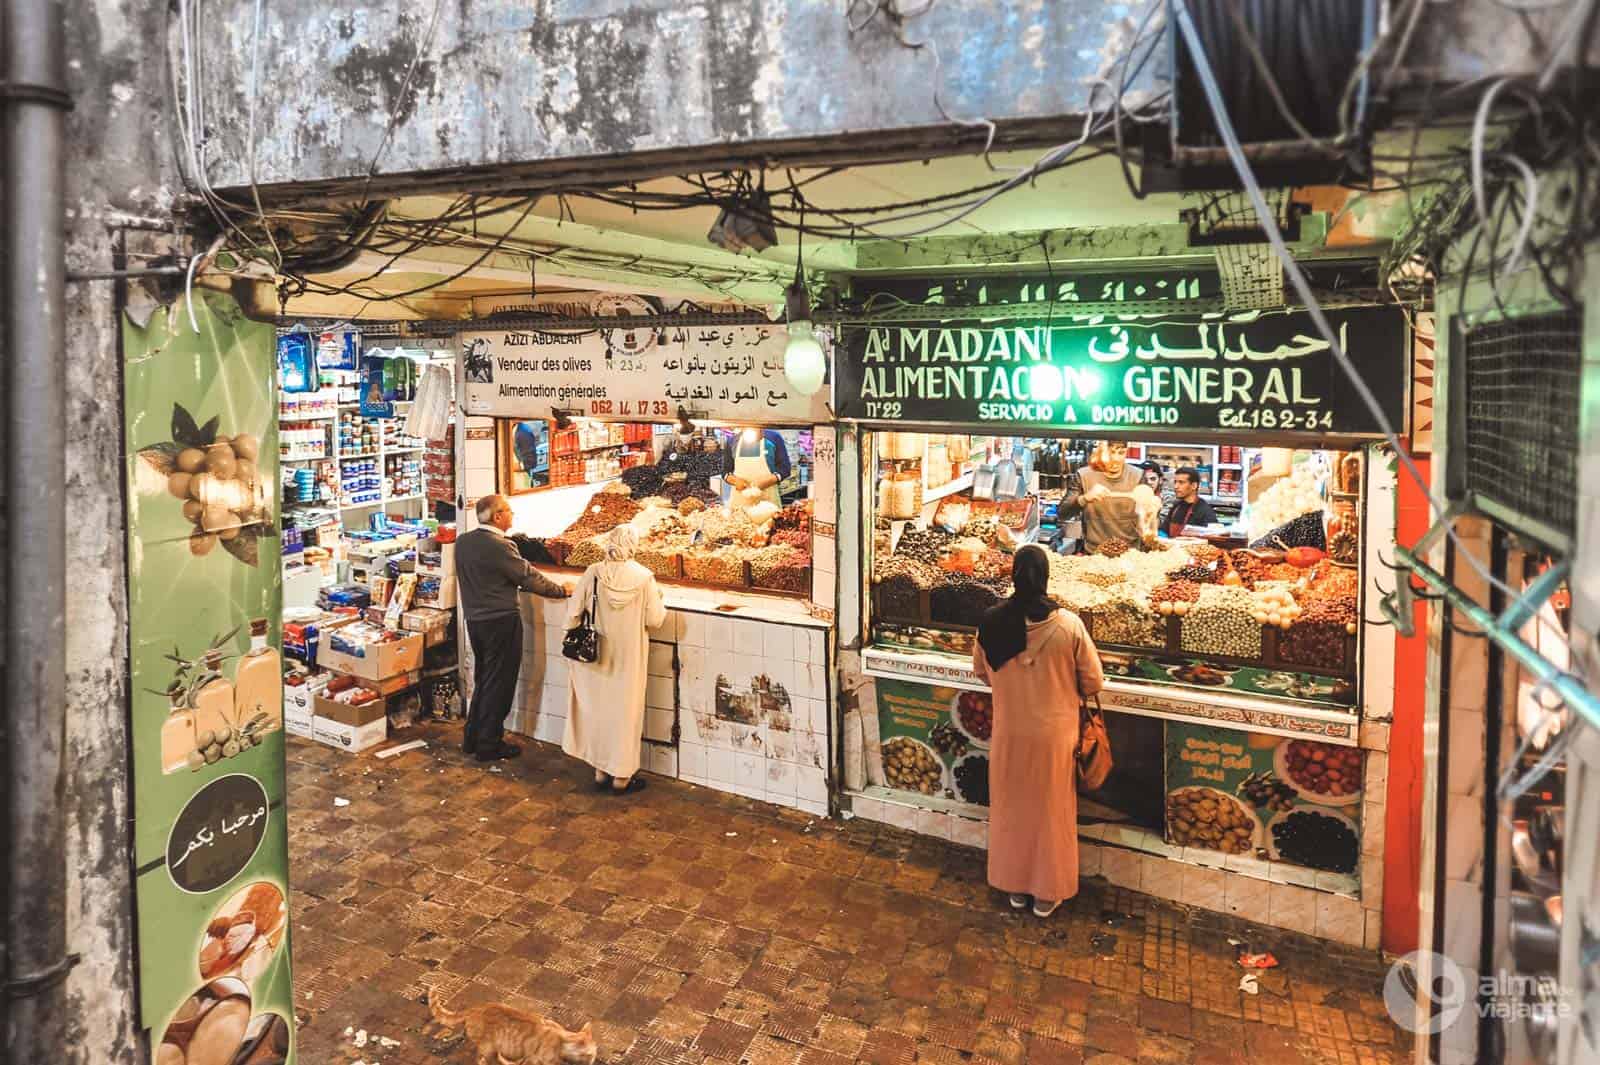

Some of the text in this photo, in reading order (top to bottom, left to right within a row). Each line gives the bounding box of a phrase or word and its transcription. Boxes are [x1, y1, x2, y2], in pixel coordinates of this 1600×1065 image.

[504, 334, 529, 346] AZIZI
[698, 329, 722, 348] عبد
[497, 356, 593, 372] Vendeur des olives
[499, 384, 608, 401] Alimentation générales
[860, 365, 1321, 405] ALIMENTACN GENERAL
[766, 391, 788, 406] مع
[591, 400, 613, 415] 062
[638, 400, 649, 416] 17
[653, 401, 669, 416] 33
[978, 402, 1179, 425] SERVICIO A DOMICILIO
[171, 806, 265, 870] مرحبا بكم
